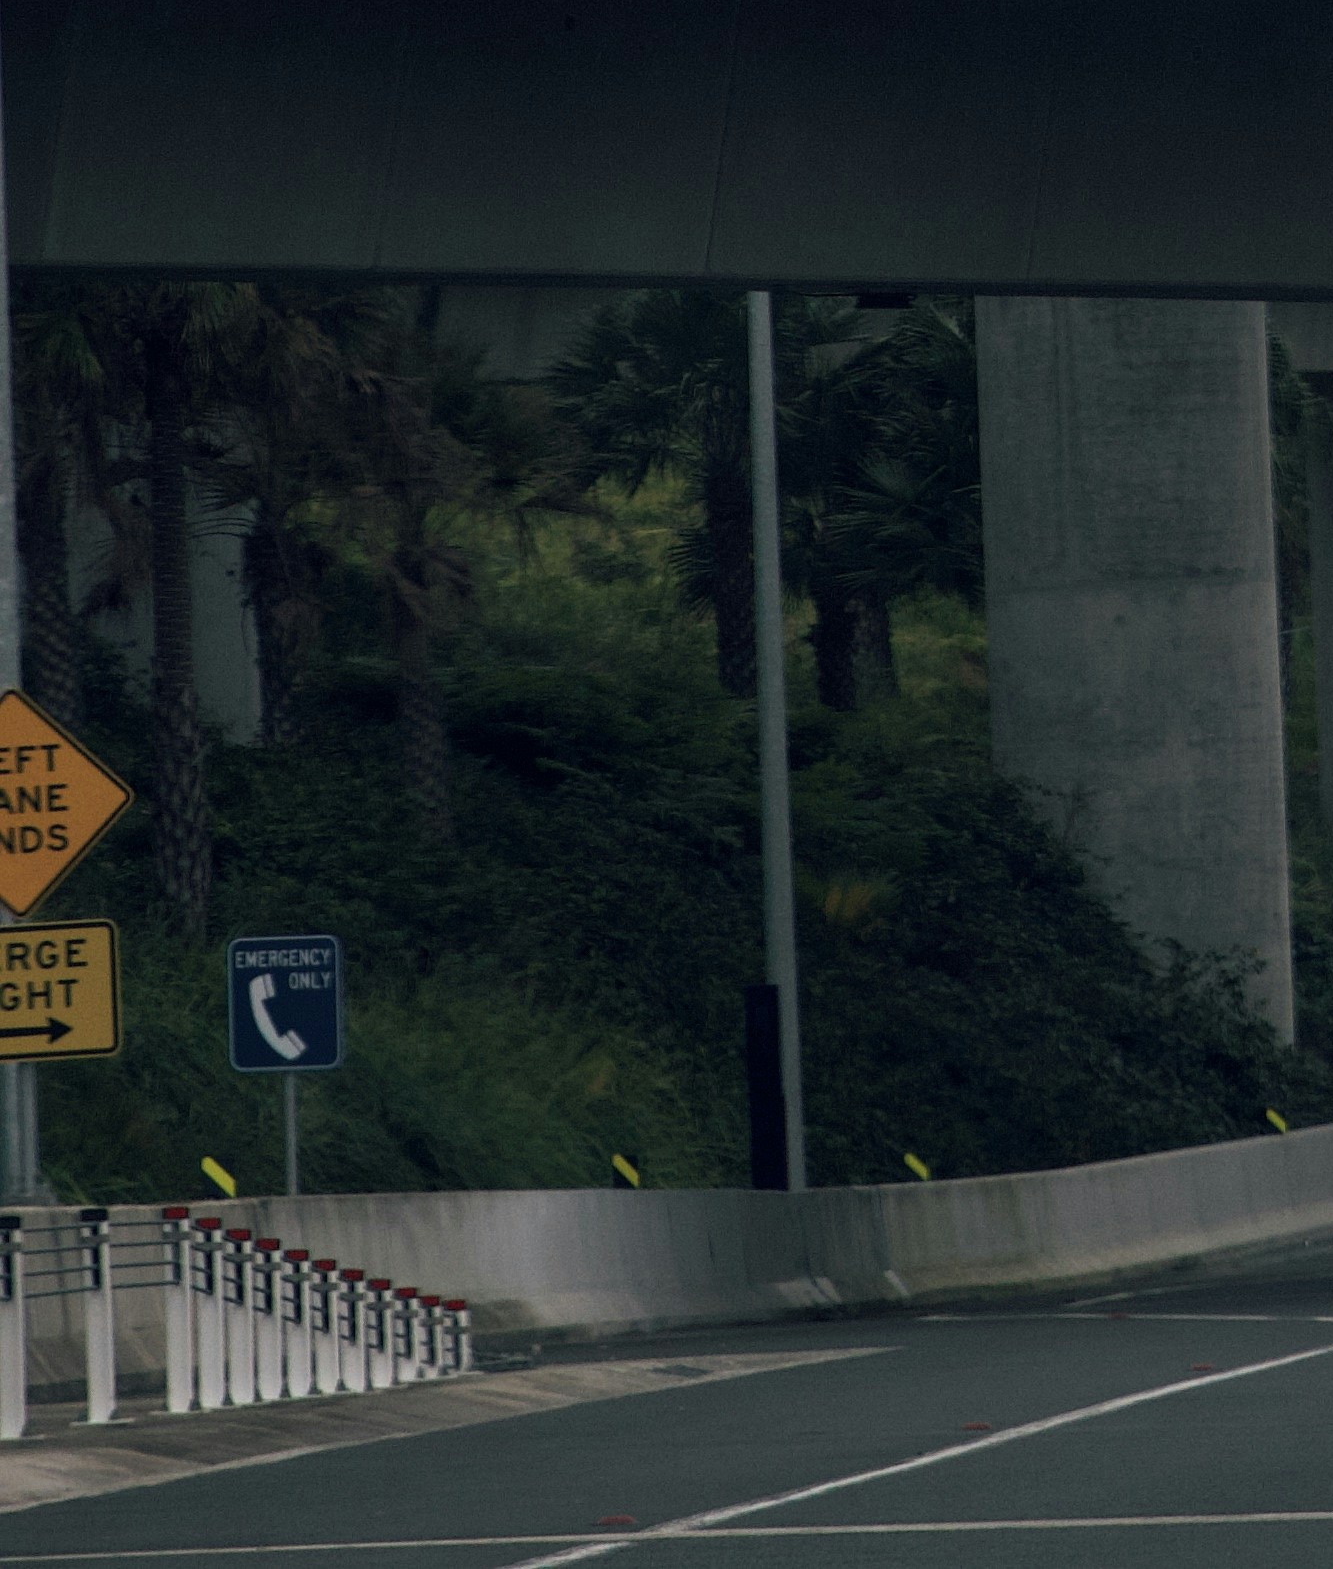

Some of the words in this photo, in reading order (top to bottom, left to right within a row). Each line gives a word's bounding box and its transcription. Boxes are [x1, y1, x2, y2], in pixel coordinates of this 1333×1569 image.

[0, 939, 88, 971] RGE
[234, 948, 331, 969] EMERGENCY
[288, 972, 331, 989] ONLY
[0, 979, 79, 1011] GHT
